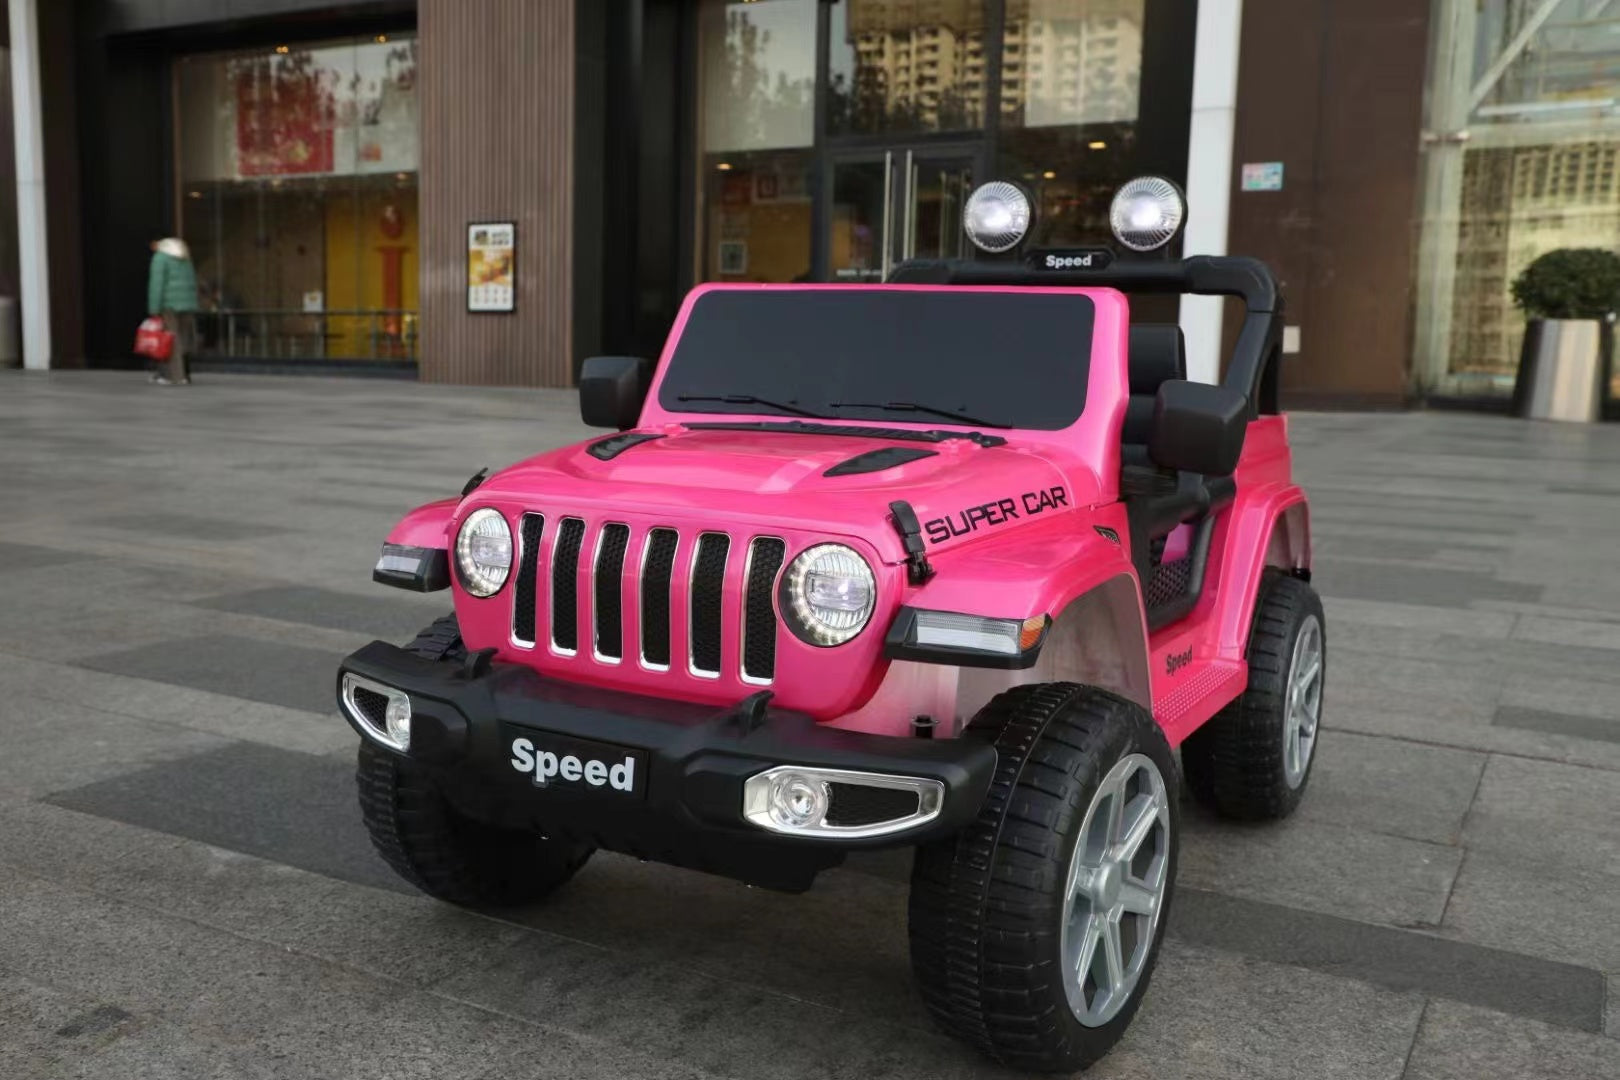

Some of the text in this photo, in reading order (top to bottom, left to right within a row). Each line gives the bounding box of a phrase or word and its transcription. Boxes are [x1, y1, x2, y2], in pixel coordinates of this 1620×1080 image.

[1045, 253, 1092, 269] Speed
[924, 486, 1068, 545] SUPER CAR
[1166, 644, 1193, 677] Speed
[511, 737, 635, 792] Speed
